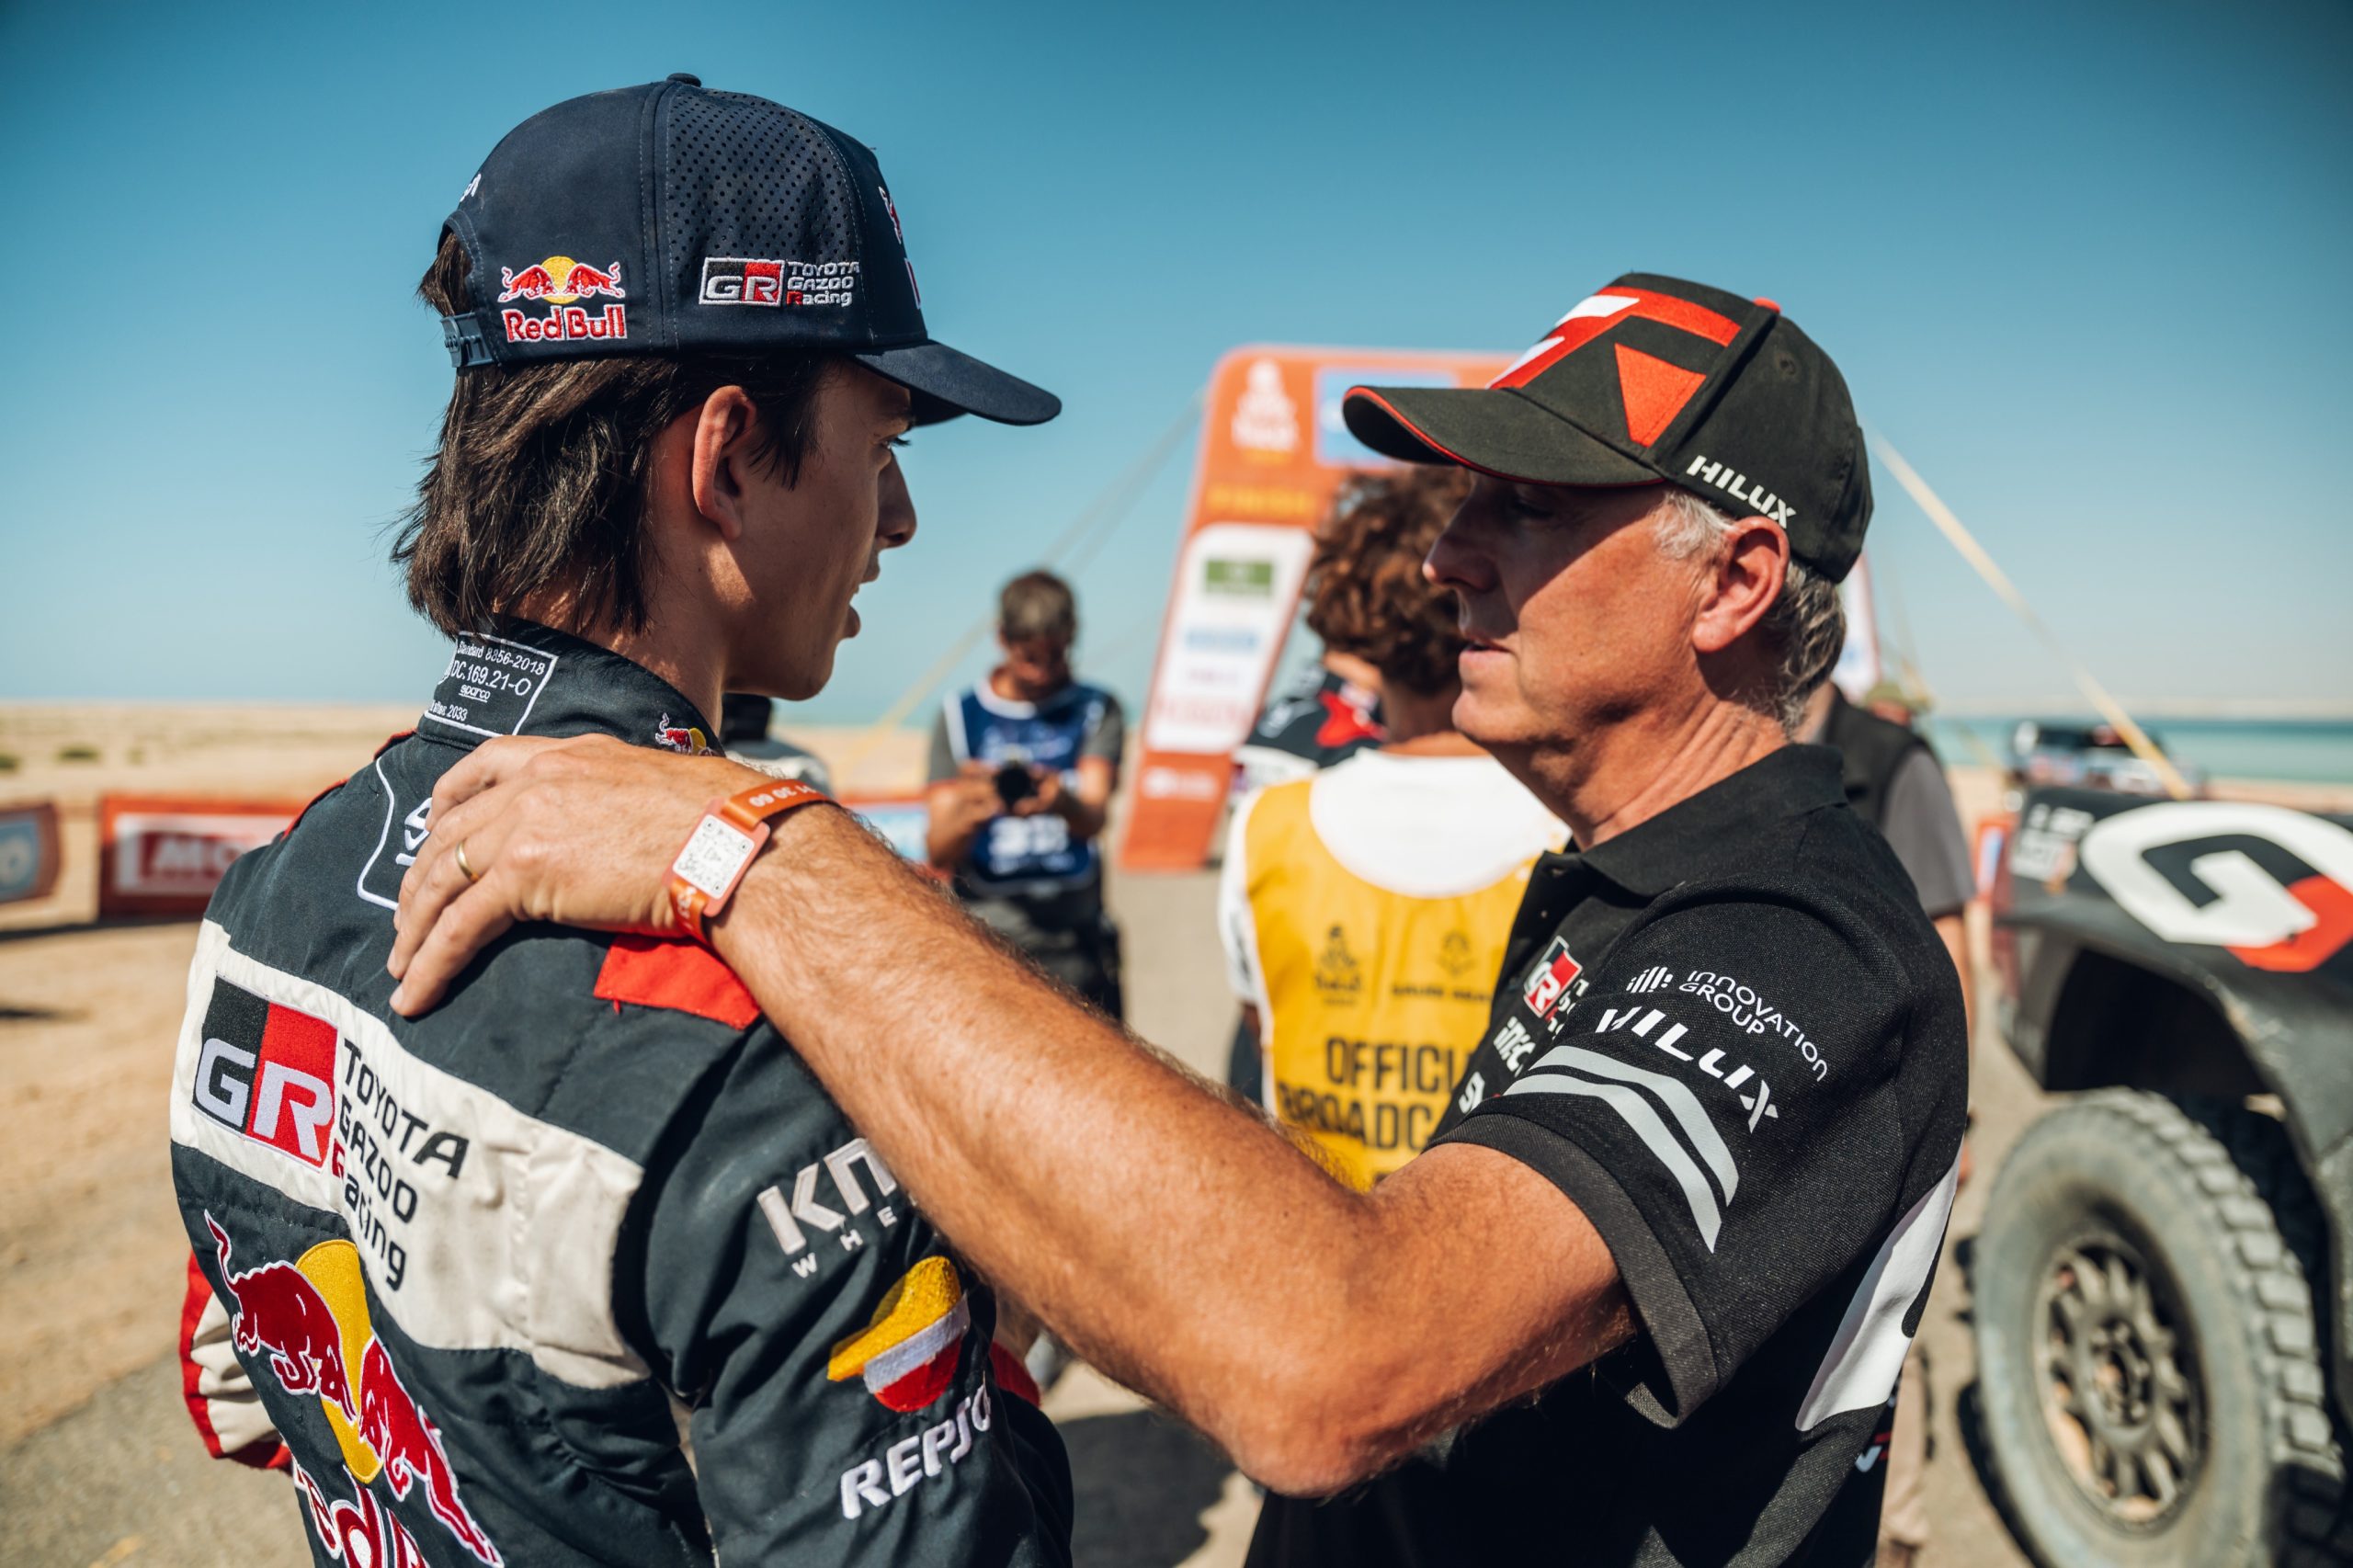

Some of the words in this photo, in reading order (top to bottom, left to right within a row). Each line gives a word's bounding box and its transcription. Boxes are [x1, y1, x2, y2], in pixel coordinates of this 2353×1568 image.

[787, 261, 860, 277] TOYOTA
[787, 277, 855, 290] GAZOO
[786, 290, 853, 307] Racing
[501, 305, 565, 343] Red
[563, 303, 628, 341] Bull
[1686, 455, 1797, 529] HILUX
[485, 647, 546, 676] 8856-2018
[460, 684, 491, 700] sparco
[447, 703, 468, 722] 2033
[1678, 982, 1766, 1035] GROUP
[1325, 1037, 1474, 1096] OFFICI
[195, 1038, 334, 1162] GR
[344, 1038, 470, 1180] TOYOTA
[337, 1094, 418, 1224] GAZOO
